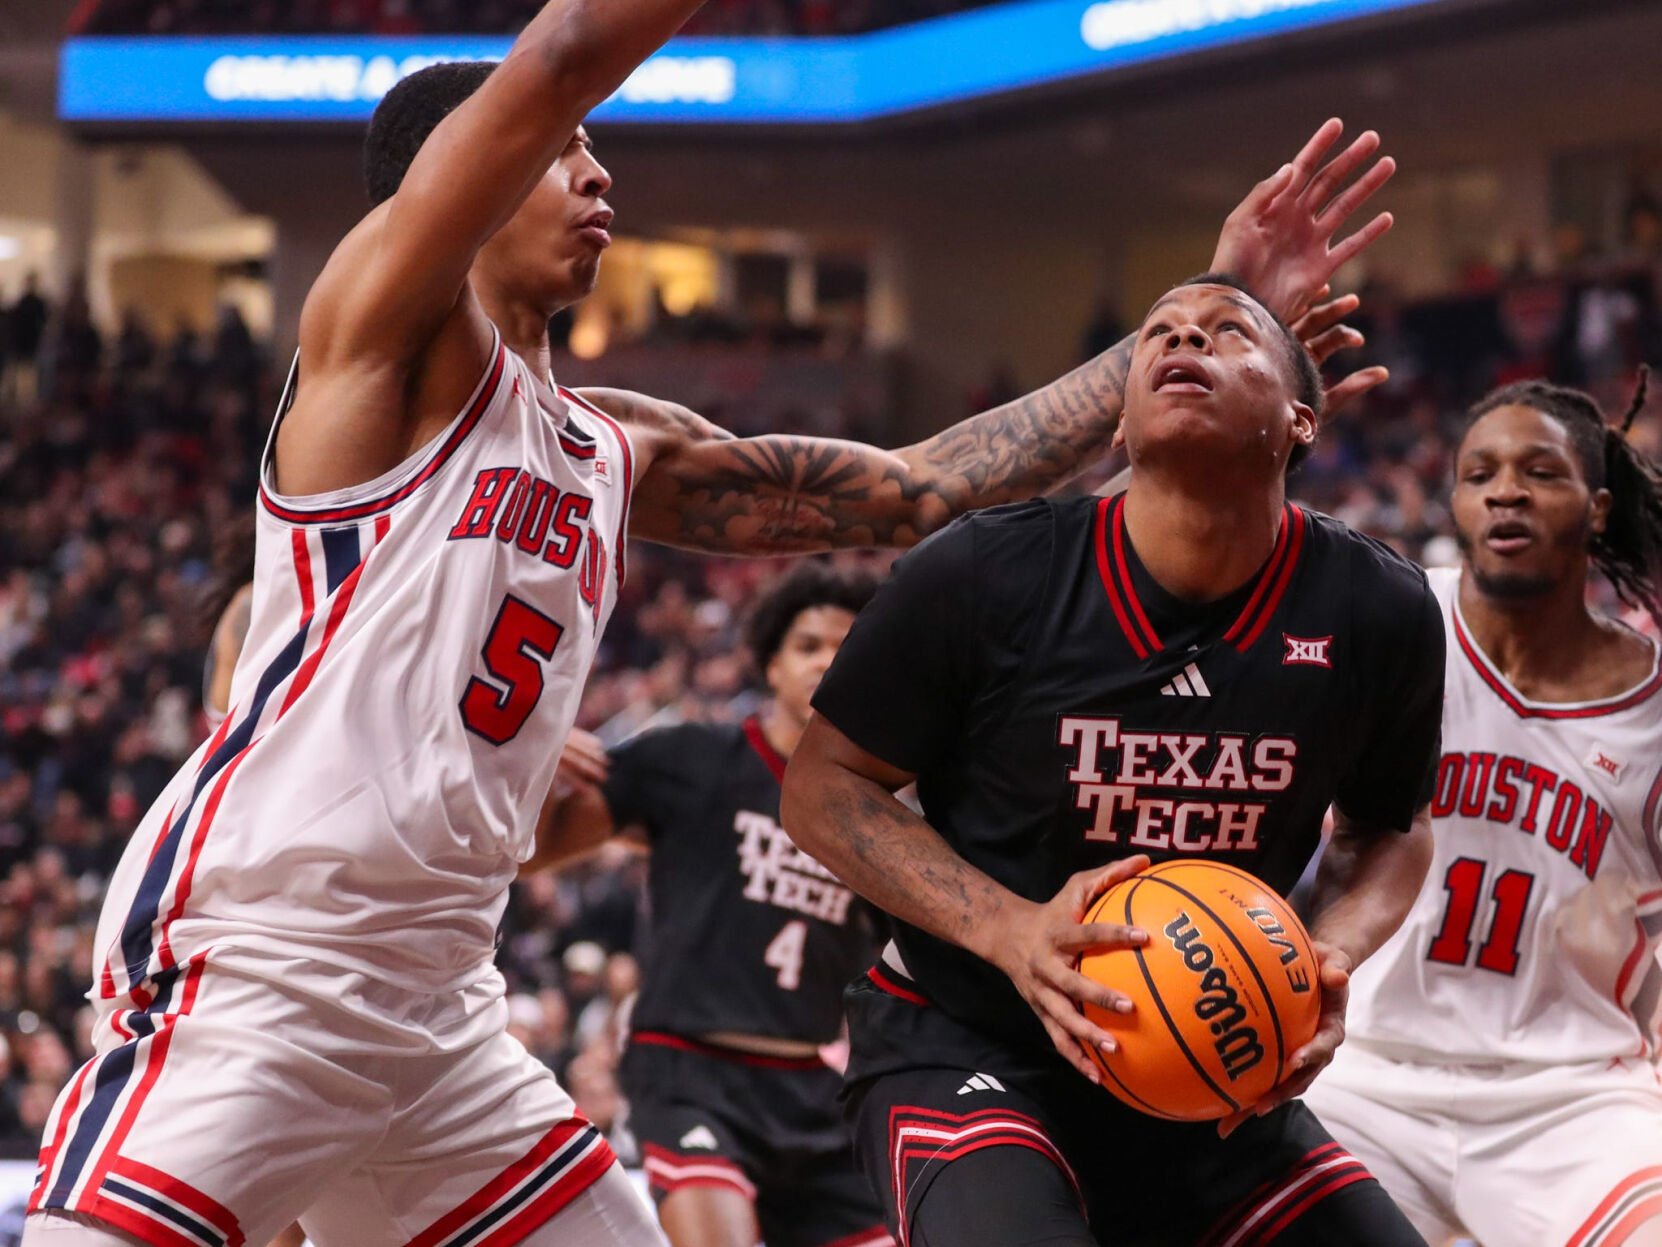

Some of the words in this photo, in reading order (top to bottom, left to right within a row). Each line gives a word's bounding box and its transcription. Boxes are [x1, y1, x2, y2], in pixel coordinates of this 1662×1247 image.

[459, 592, 564, 747] 5
[1430, 752, 1614, 882] OUSTON
[764, 918, 808, 991] 4
[1426, 856, 1536, 977] 11
[1164, 911, 1264, 1082] Wilson
